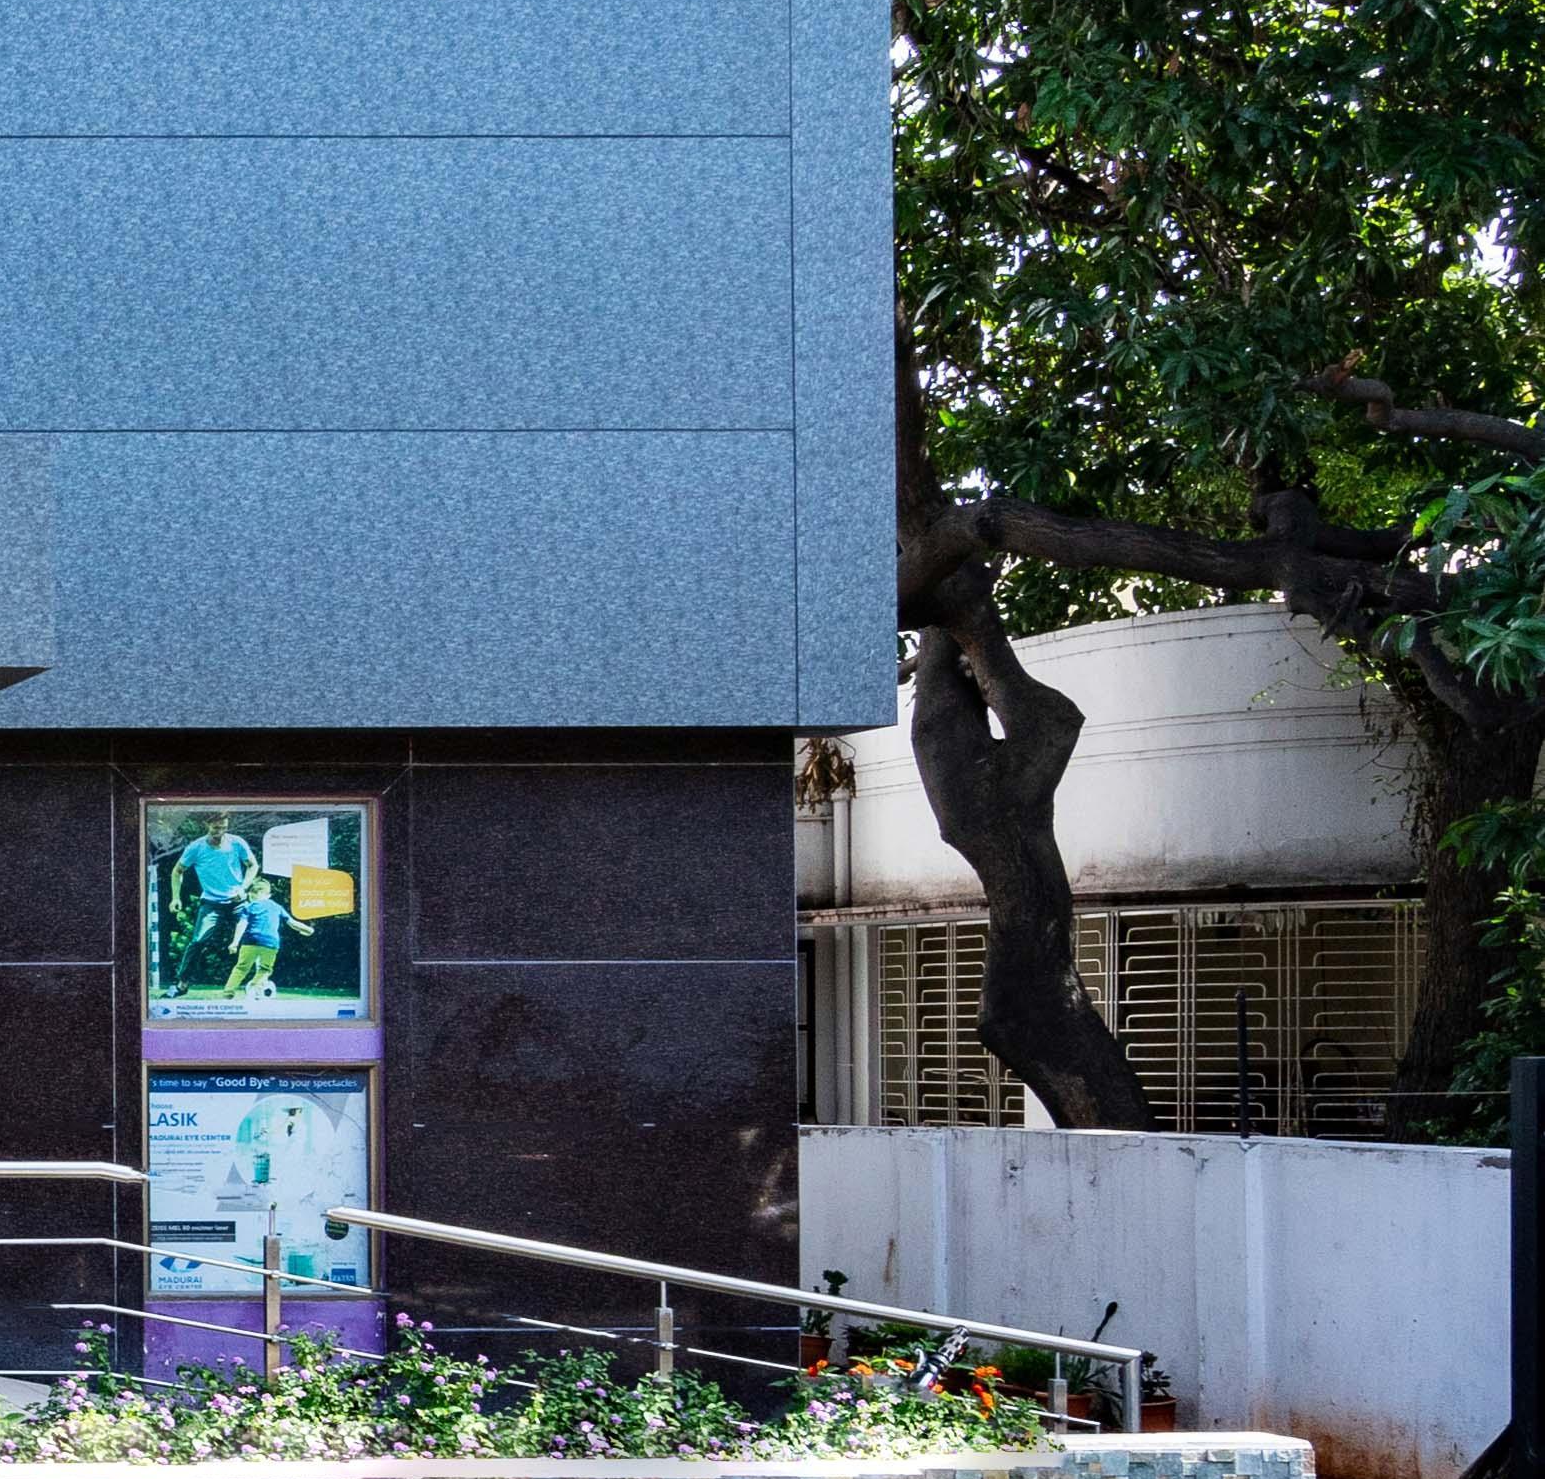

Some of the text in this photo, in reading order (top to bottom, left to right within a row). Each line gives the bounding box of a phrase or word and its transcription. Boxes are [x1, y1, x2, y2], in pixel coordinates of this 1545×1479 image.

[181, 1079, 191, 1087] to
[193, 1080, 208, 1089] say
[291, 1080, 310, 1089] your
[313, 1078, 357, 1089] spectacles
